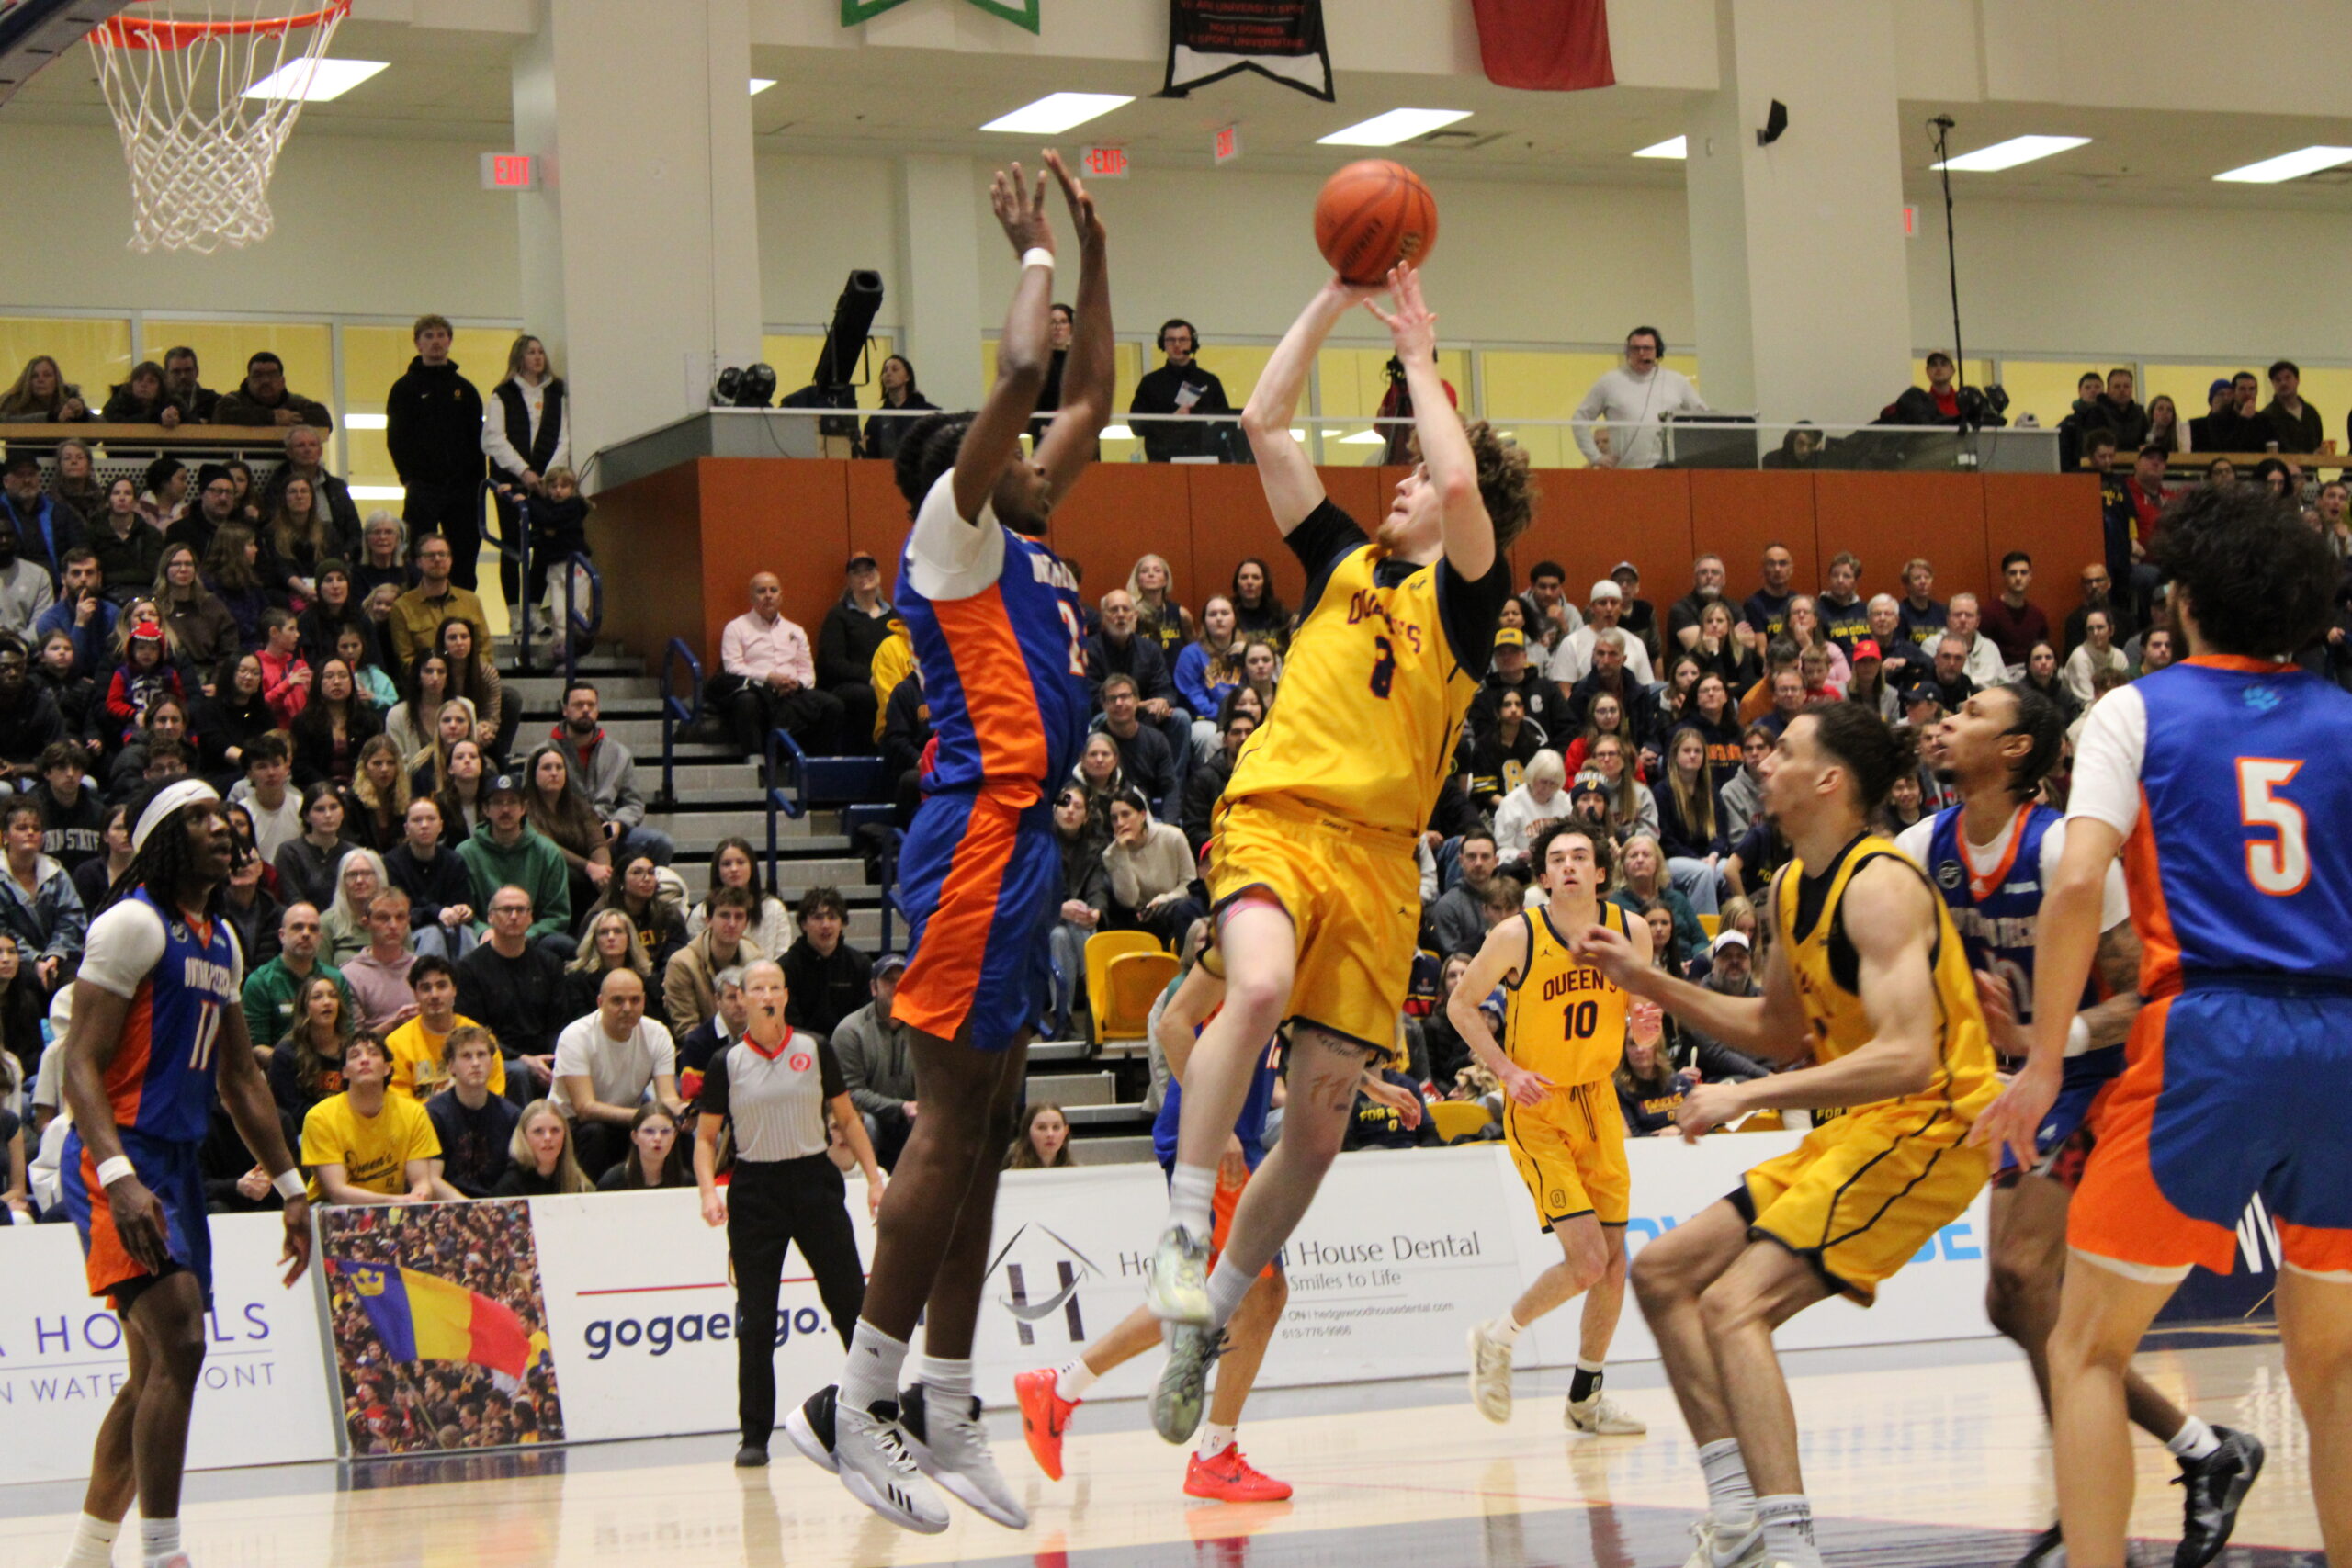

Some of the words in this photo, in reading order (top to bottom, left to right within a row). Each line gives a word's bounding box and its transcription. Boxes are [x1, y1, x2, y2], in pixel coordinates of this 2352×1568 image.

[1216, 129, 1233, 158] EXIT
[494, 155, 529, 186] EXIT
[1092, 149, 1122, 175] EXIT
[66, 828, 100, 852] STATE
[2234, 756, 2312, 897] 5
[188, 999, 220, 1071] 11
[1564, 1000, 1597, 1041] 10
[1299, 1240, 1384, 1266] House
[1392, 1231, 1481, 1261] Dental
[1290, 1269, 1342, 1292] Smiles
[1347, 1271, 1367, 1288] to
[1372, 1269, 1402, 1287] Life
[35, 1302, 270, 1355] HOLS
